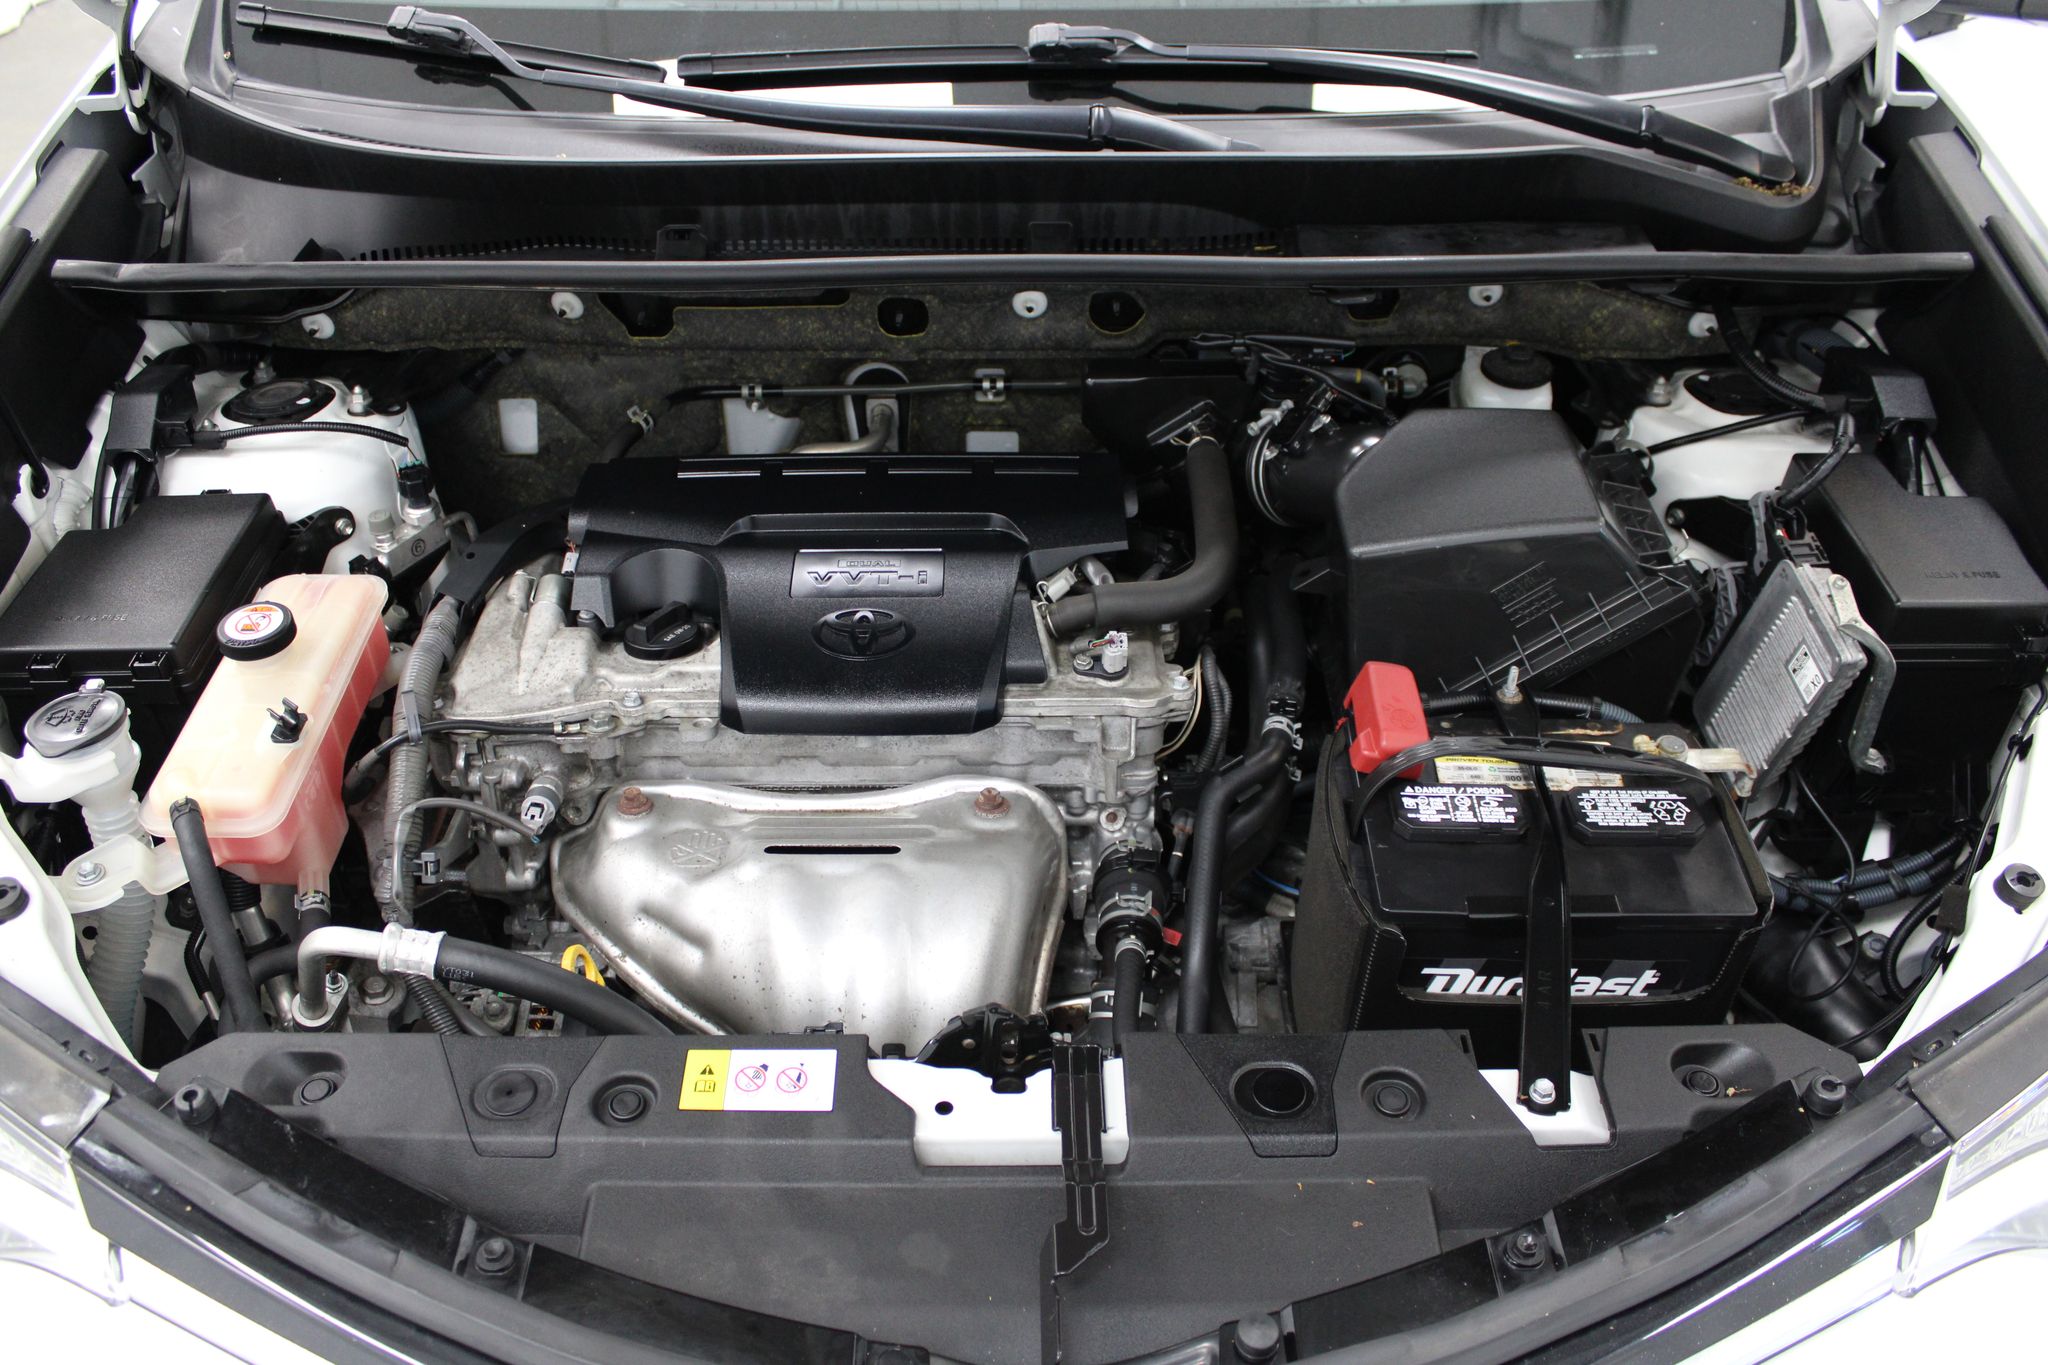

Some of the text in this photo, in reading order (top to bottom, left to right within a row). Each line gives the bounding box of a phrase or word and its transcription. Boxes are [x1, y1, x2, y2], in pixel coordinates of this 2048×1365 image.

[807, 570, 928, 586] VVT-i
[1414, 785, 1457, 794] DANGER
[1466, 787, 1504, 795] POISON
[1420, 967, 1660, 997] Durast
